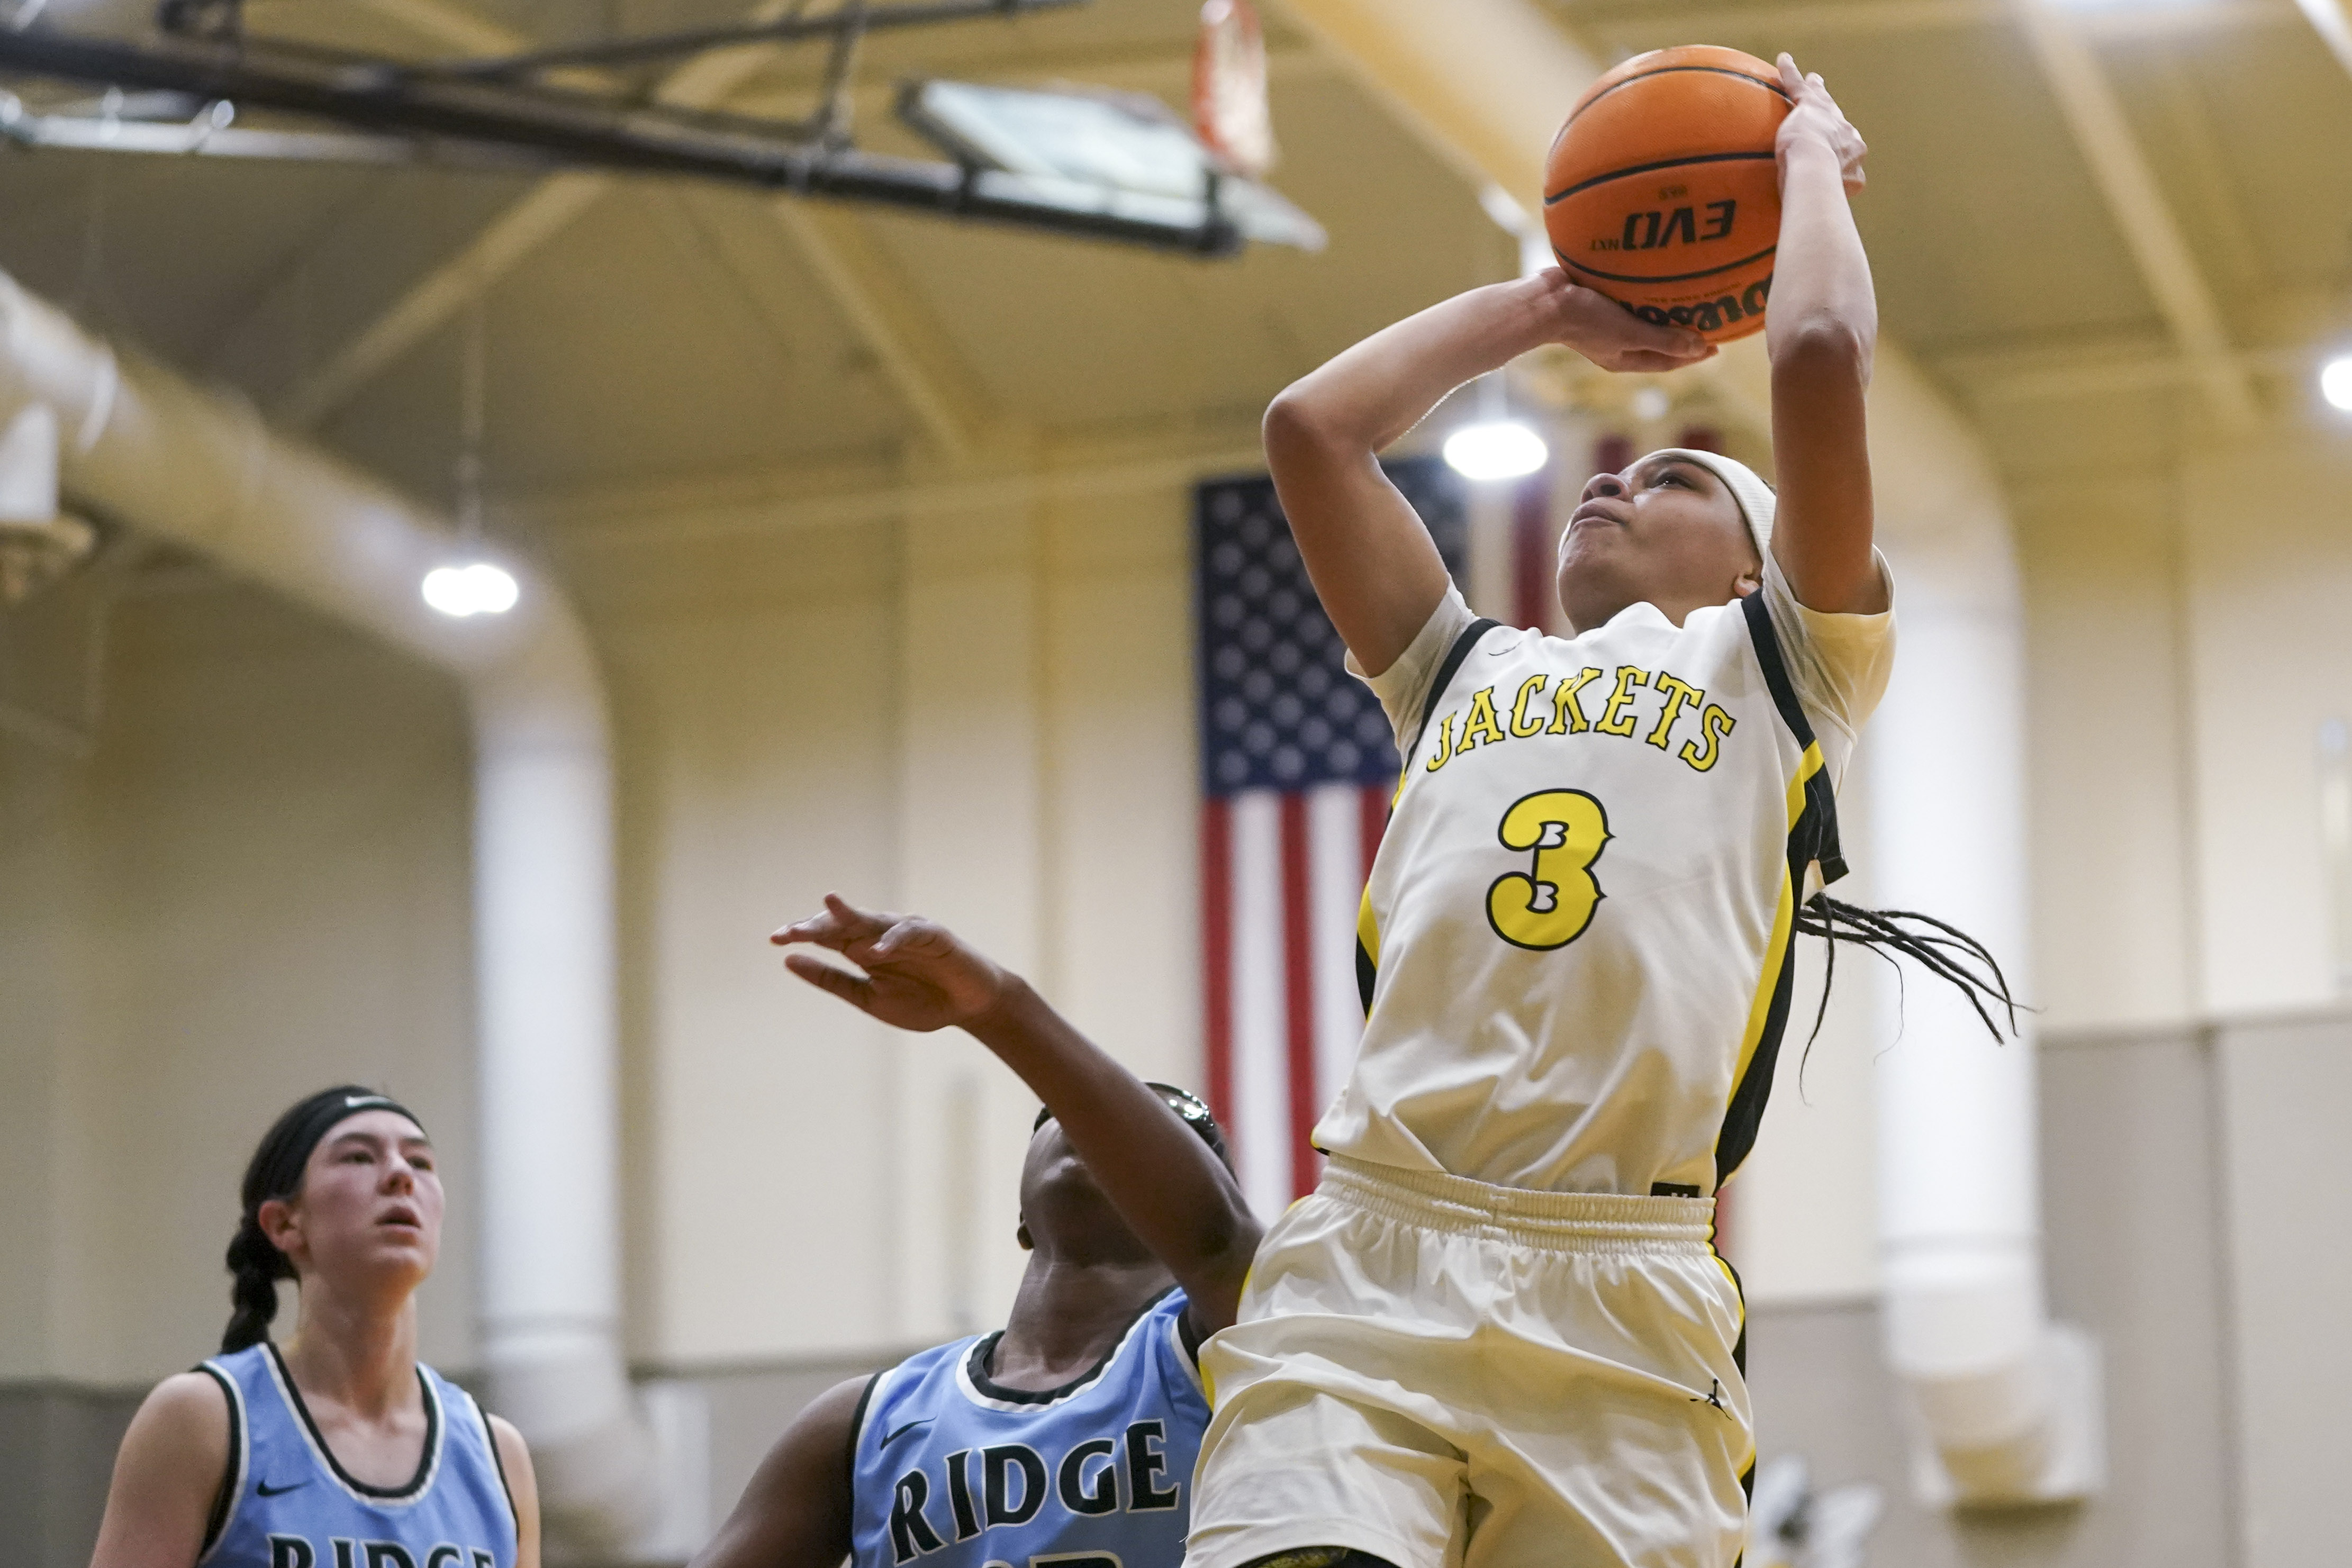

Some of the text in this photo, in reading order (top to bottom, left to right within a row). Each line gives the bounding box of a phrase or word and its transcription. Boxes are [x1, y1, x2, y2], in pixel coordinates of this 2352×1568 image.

[1622, 198, 1736, 251] EVO
[1426, 665, 1736, 772] JACKETS
[1486, 788, 1616, 951] 3
[888, 1418, 1181, 1567] RIDGE
